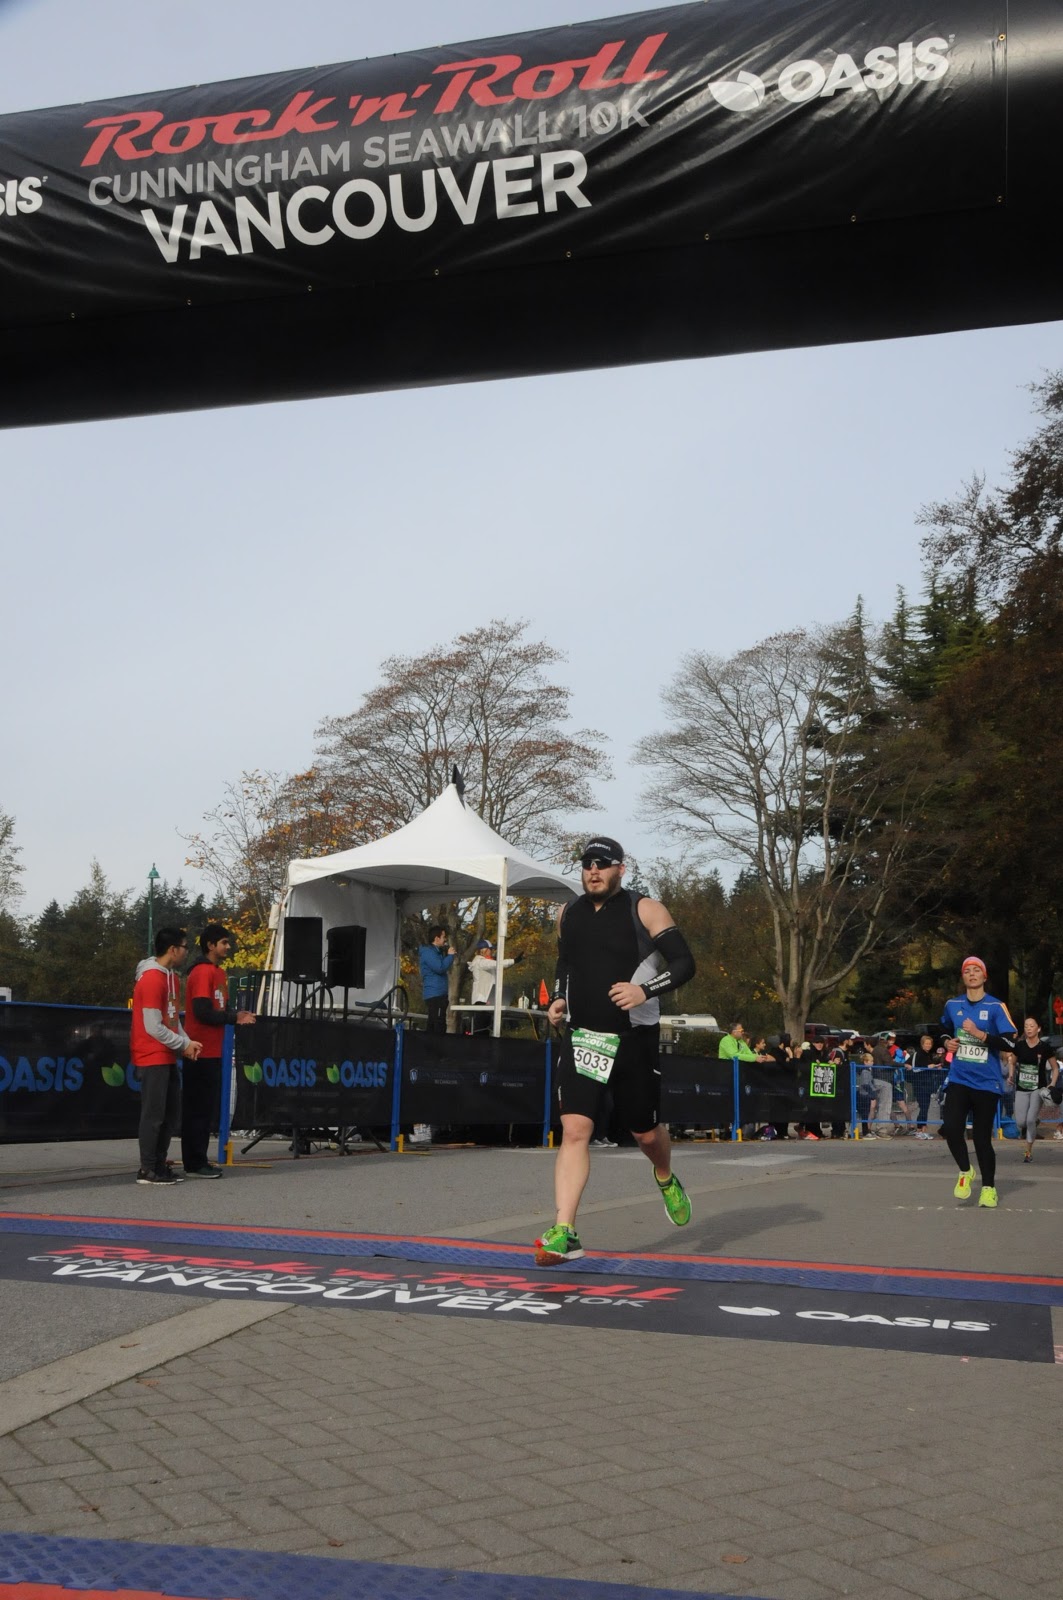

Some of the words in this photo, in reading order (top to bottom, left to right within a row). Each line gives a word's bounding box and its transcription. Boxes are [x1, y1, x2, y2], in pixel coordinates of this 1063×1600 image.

[778, 37, 949, 103] OASIS
[80, 90, 339, 167] Rock
[432, 32, 669, 115] Roll
[88, 140, 350, 206] CUNNINGHAM
[363, 111, 562, 168] SEAWALL
[573, 95, 650, 138] 10K
[141, 149, 592, 263] VANCOUVER
[262, 1057, 317, 1087] OASIS
[340, 1060, 388, 1088] OASIS
[959, 1045, 986, 1056] 11607
[27, 1255, 316, 1284] CUNNINGHAM
[321, 1277, 545, 1300] SEAWALL
[563, 1295, 650, 1308] 10K
[52, 1264, 563, 1315] VANCOUVER
[795, 1310, 990, 1332] OASIS
